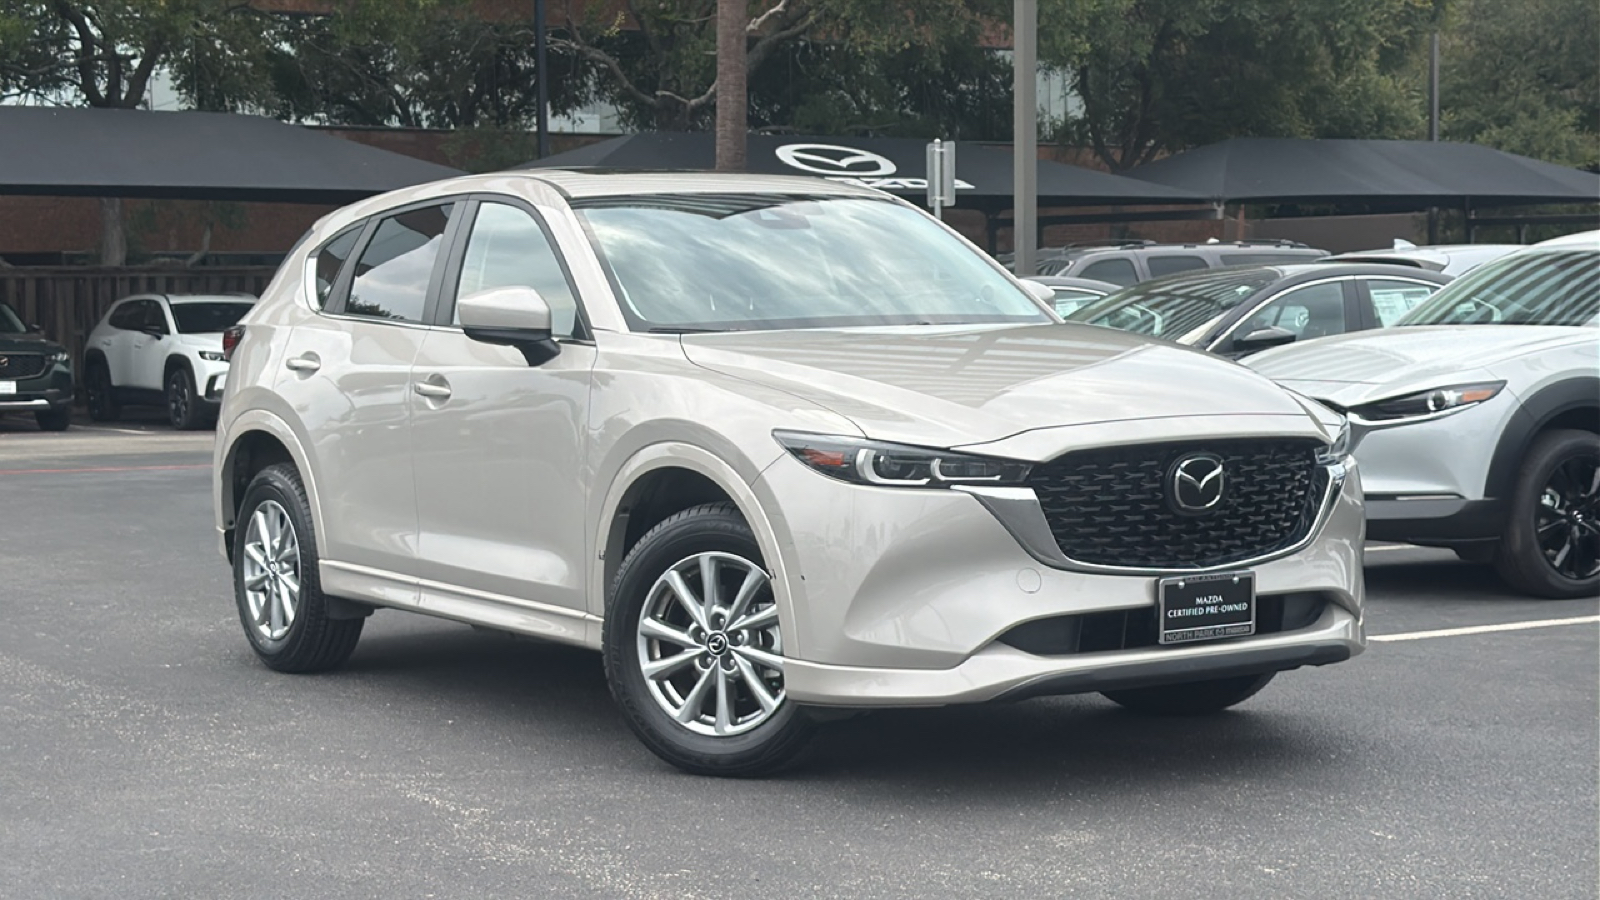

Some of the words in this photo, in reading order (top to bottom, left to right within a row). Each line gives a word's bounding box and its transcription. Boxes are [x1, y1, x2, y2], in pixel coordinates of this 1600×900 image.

[1195, 595, 1223, 605] MAZDA
[1167, 607, 1204, 618] CERTIFIED
[1205, 602, 1248, 614] PRE-OWNED
[1166, 632, 1192, 641] NORTH
[1194, 629, 1214, 638] PARK
